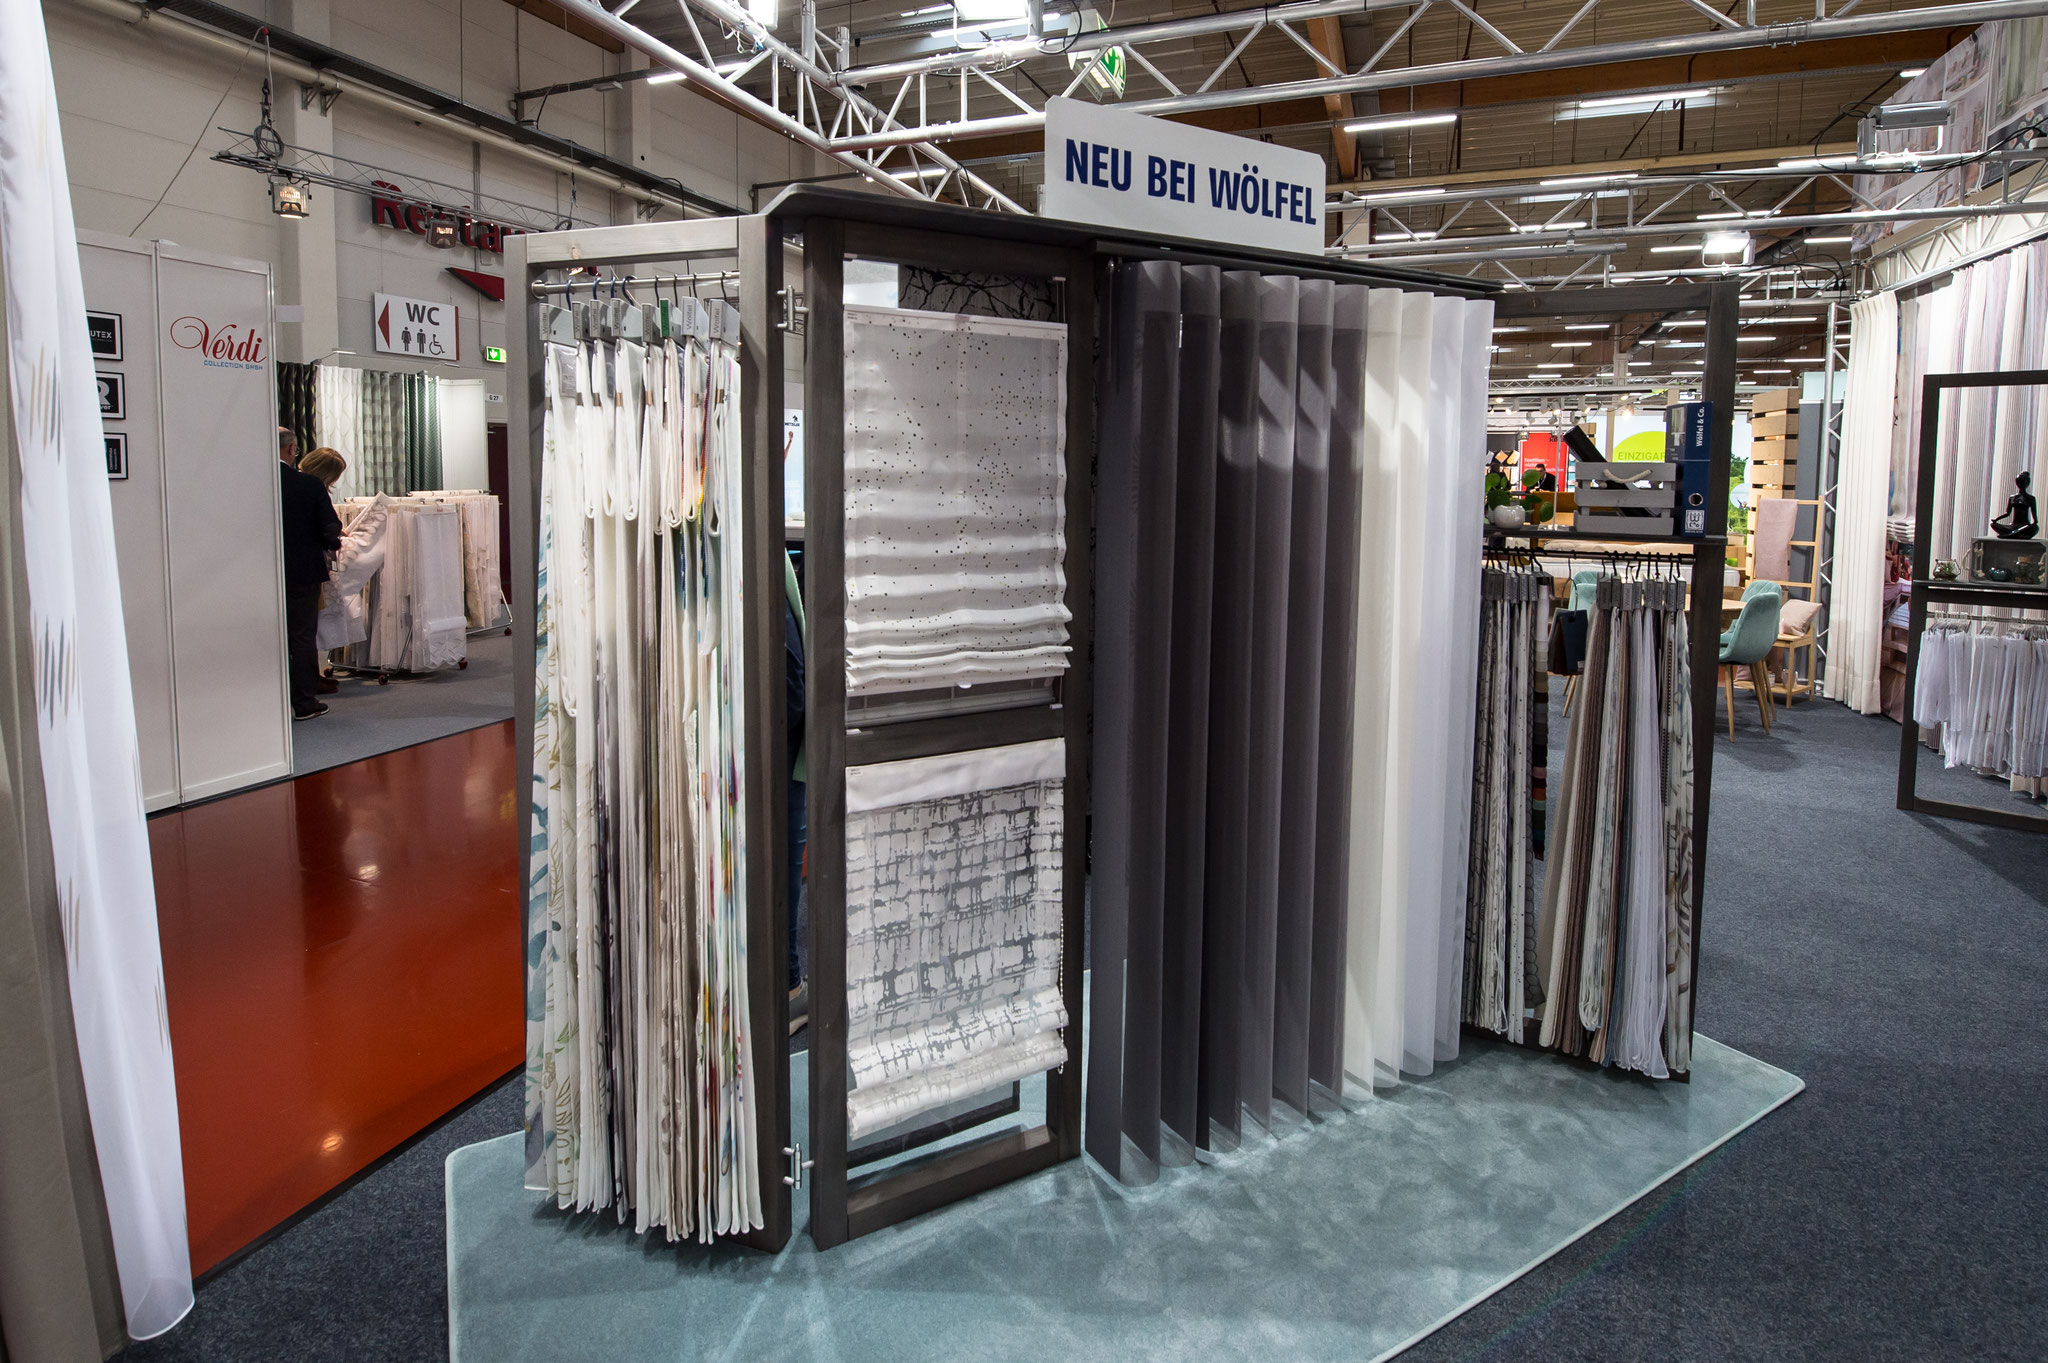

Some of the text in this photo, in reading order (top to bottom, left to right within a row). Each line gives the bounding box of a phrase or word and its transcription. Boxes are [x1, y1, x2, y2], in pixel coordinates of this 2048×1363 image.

[1065, 138, 1317, 225] NEU BEI WÖLFEL
[405, 302, 440, 326] WC
[170, 316, 267, 363] Verdi
[203, 359, 243, 369] COLLECTION
[1697, 406, 1706, 417] Co.
